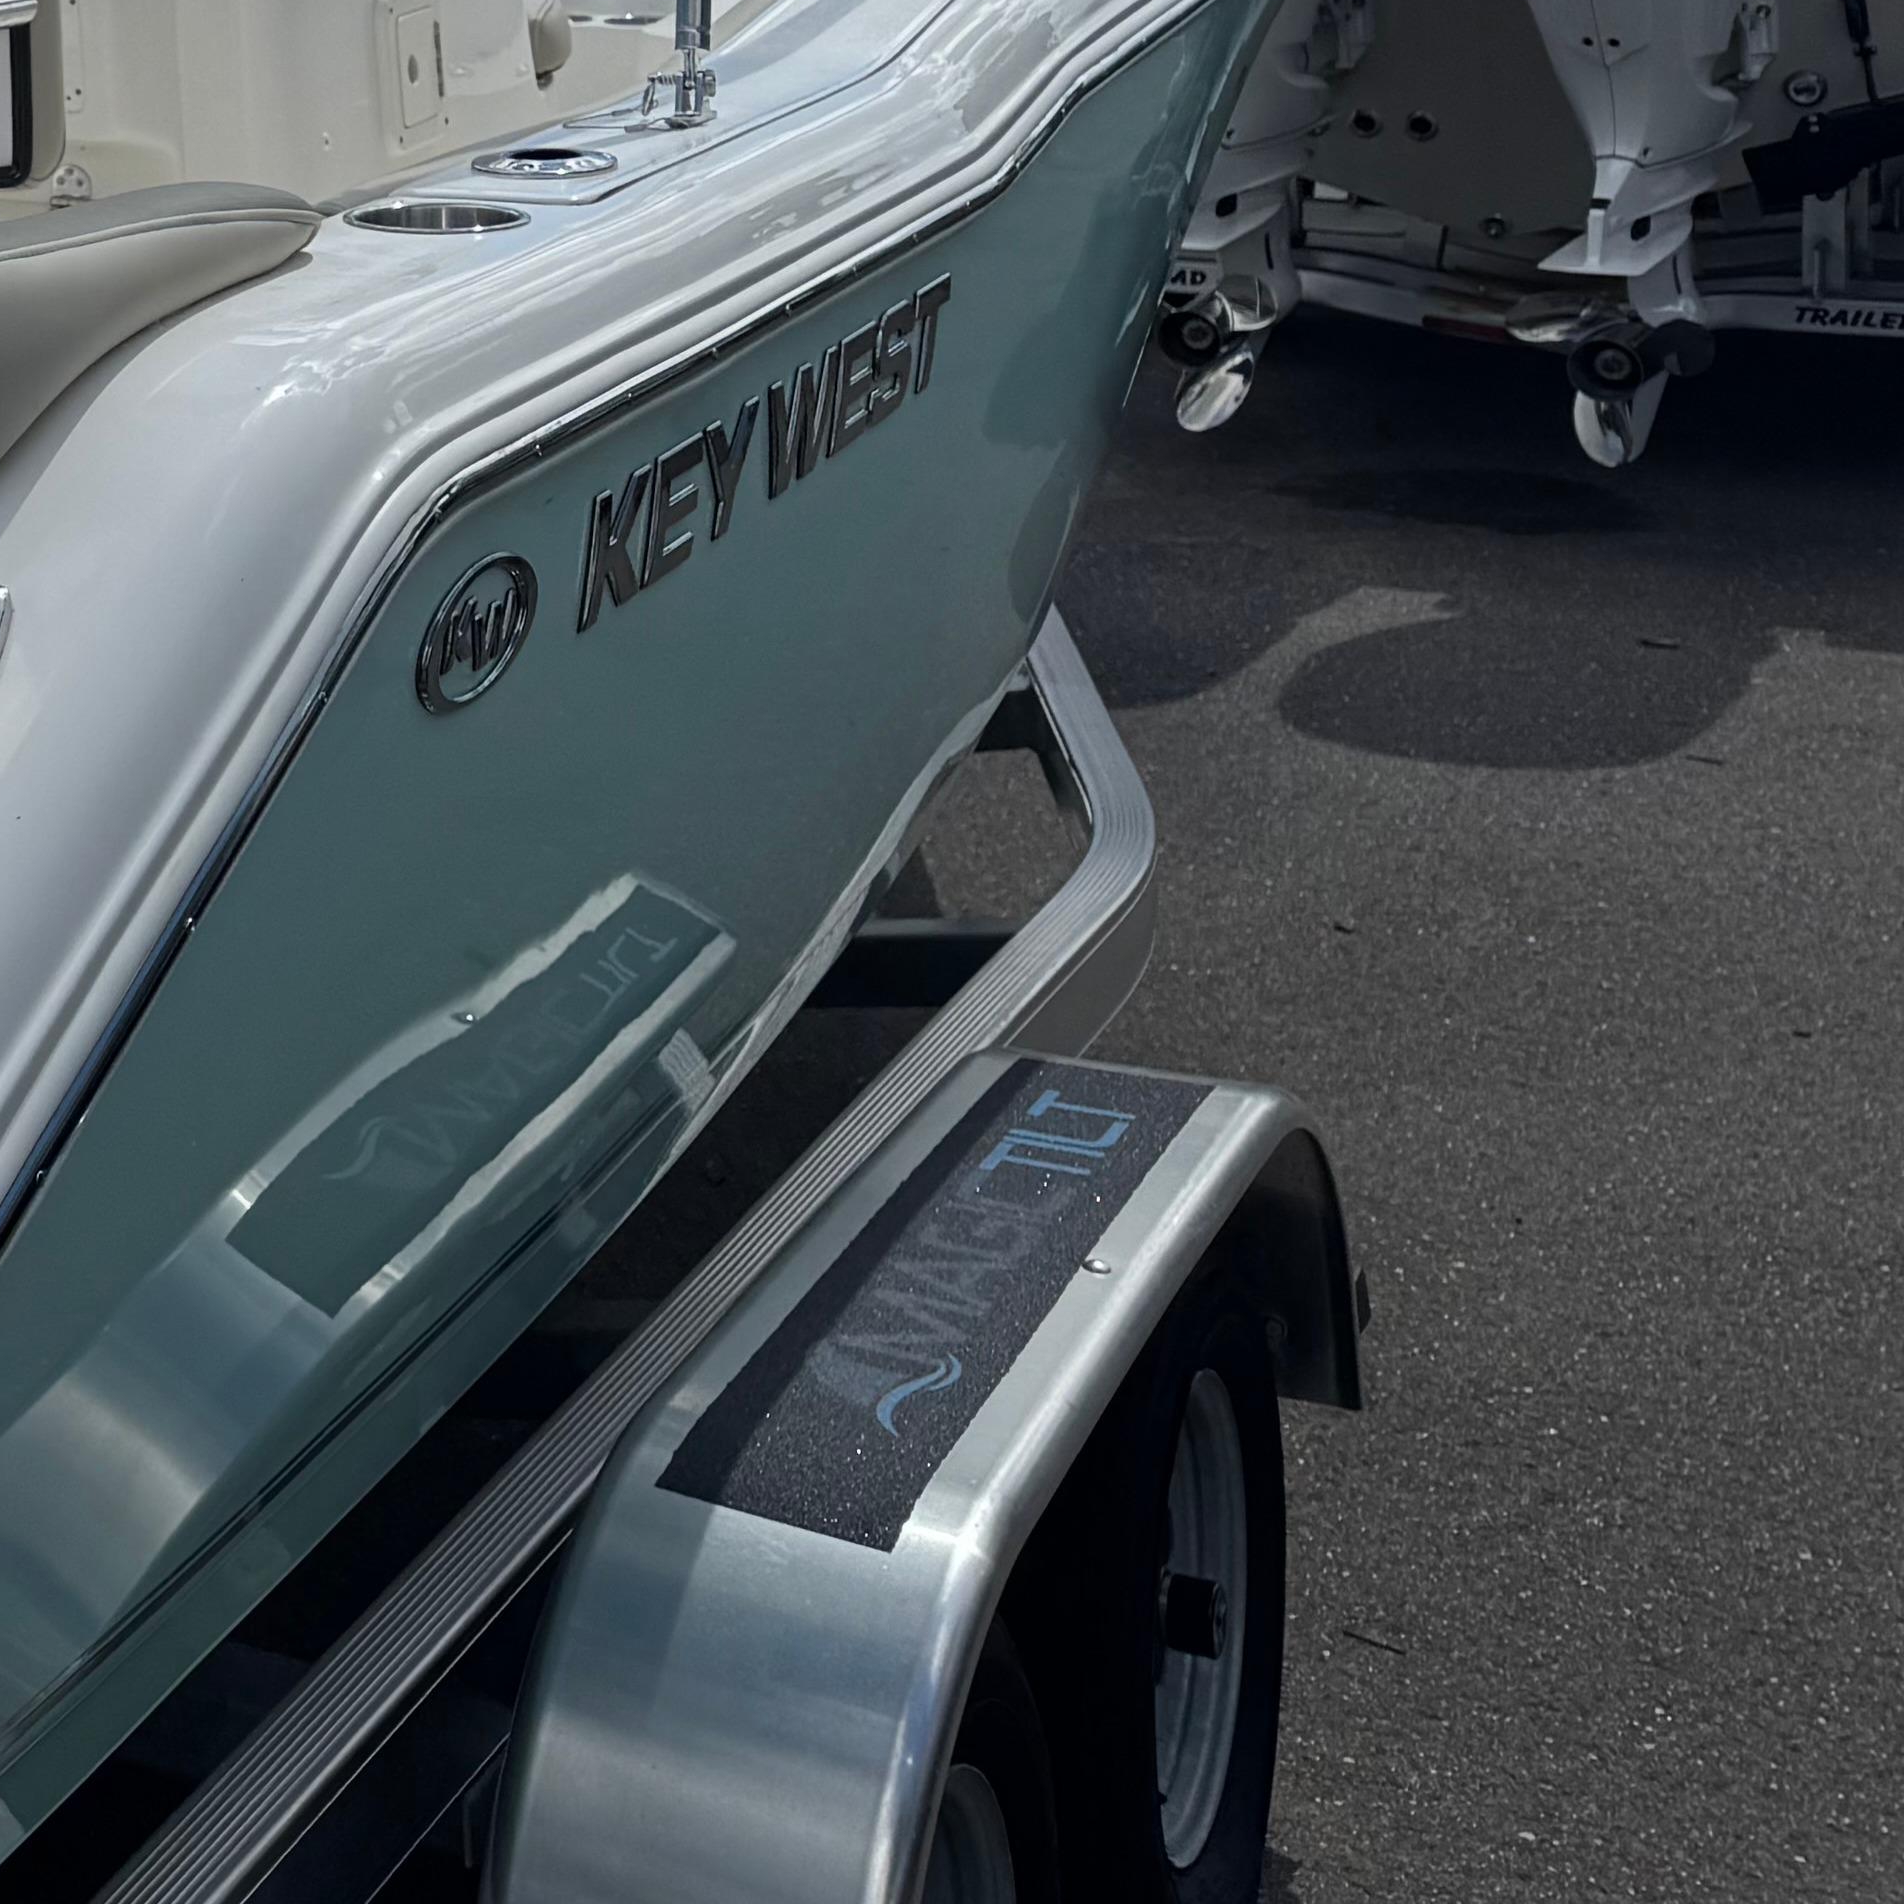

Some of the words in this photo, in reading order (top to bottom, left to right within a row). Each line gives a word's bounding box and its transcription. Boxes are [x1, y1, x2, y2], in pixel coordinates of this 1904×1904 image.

[576, 395, 761, 635] KEY
[766, 271, 952, 501] WEST
[979, 1089, 1137, 1176] TILT
